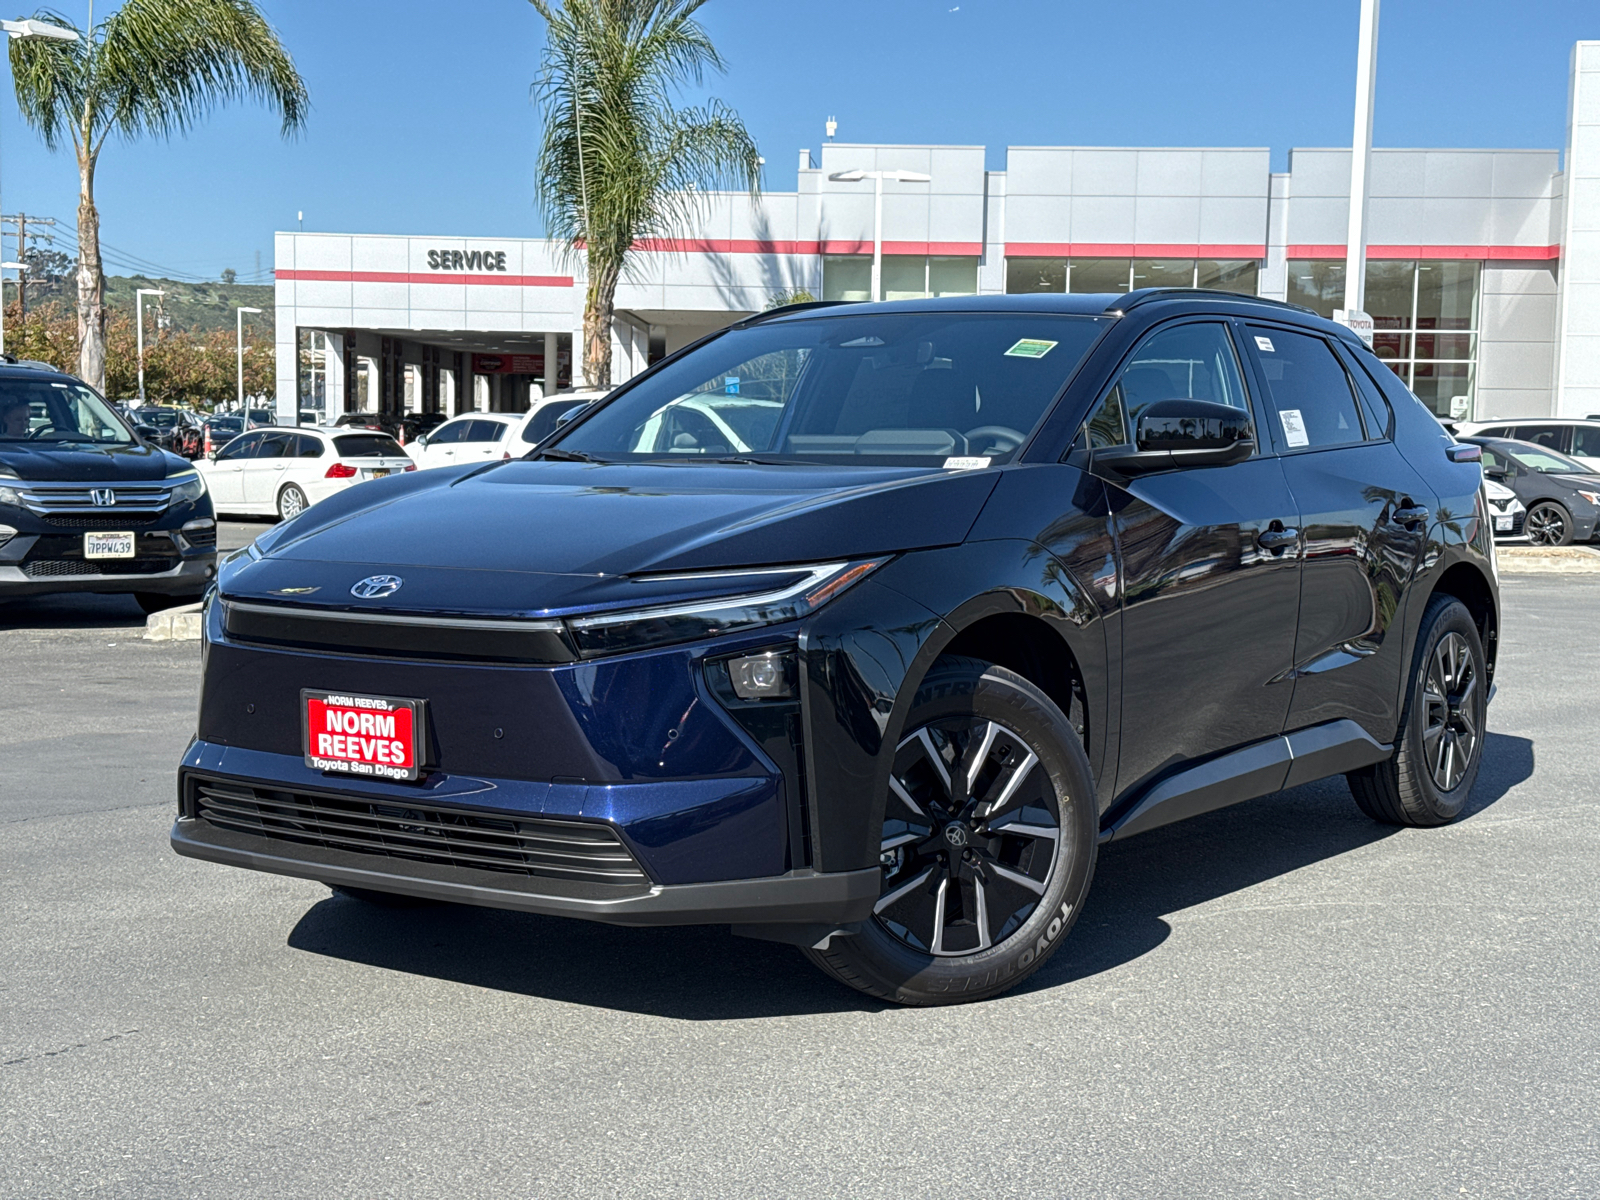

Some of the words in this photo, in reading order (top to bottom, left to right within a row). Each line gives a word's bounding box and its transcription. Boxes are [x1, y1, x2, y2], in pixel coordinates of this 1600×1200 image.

[427, 249, 507, 272] SERVICE
[1349, 319, 1372, 330] TOYOTA
[327, 695, 354, 707] NORM
[354, 697, 388, 711] REEVES
[326, 709, 396, 739] NORM
[317, 733, 406, 765] REEVES
[311, 756, 349, 771] Toyota
[350, 761, 373, 774] San
[375, 764, 409, 780] Diego
[1016, 901, 1074, 970] TOYO
[927, 962, 1017, 992] TIRES
